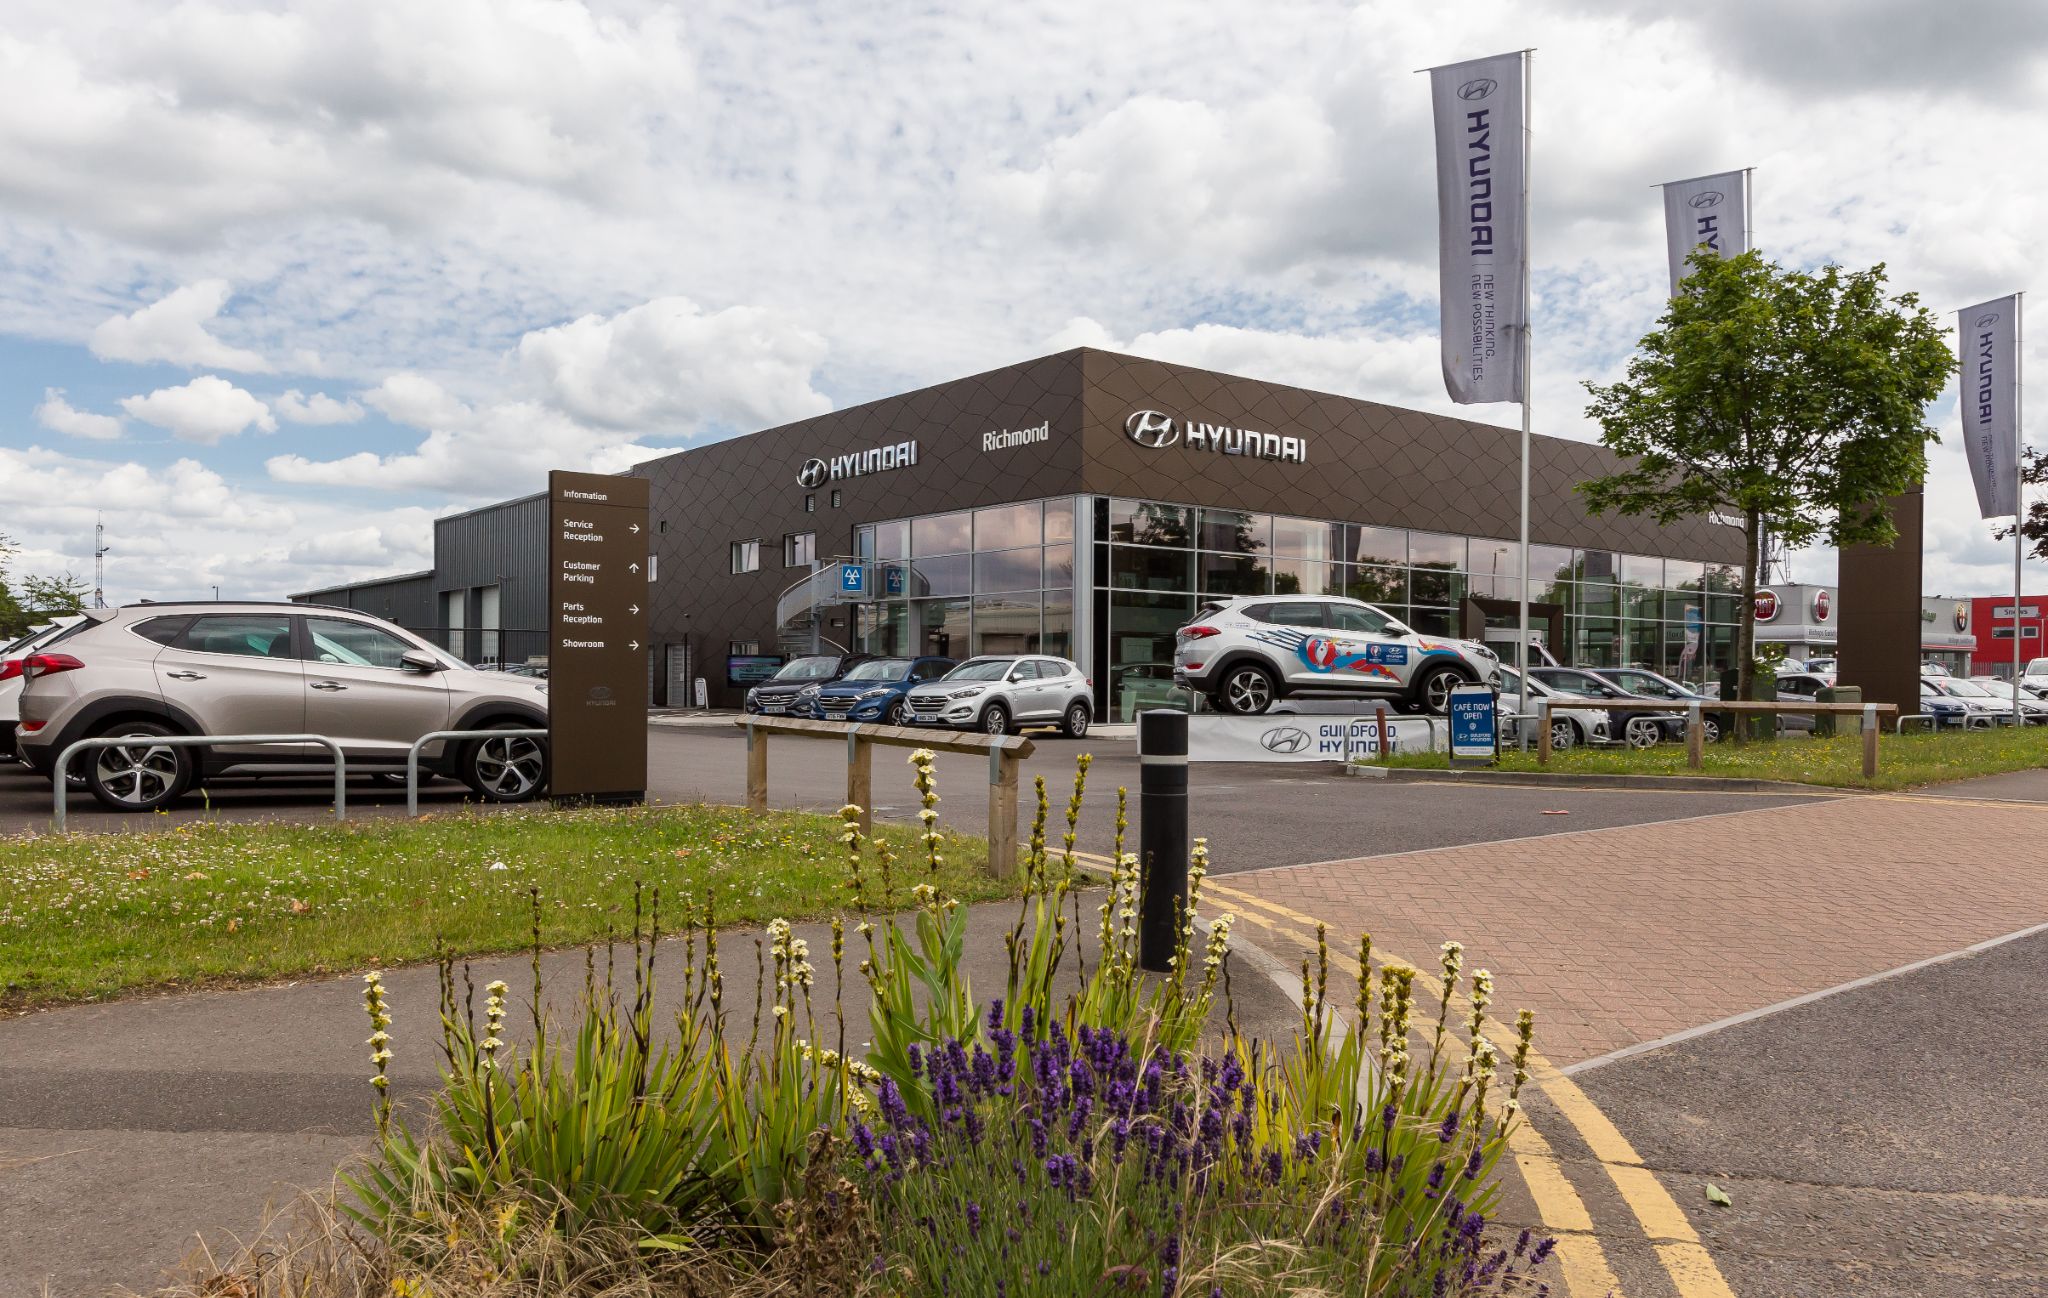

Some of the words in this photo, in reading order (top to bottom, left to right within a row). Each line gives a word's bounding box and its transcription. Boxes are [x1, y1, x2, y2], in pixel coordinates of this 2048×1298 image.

[1467, 109, 1493, 256] HYUNDAI
[1472, 274, 1482, 300] NEW
[1483, 274, 1494, 300] NEW
[1979, 332, 1993, 425] HYUNDAI
[983, 420, 1049, 452] Richmond
[1185, 421, 1306, 464] HYUNDAI
[830, 440, 918, 481] HYUNDAI
[563, 489, 608, 501] Information
[563, 519, 594, 529] Service
[563, 532, 603, 543] Reception
[563, 560, 601, 571] Customer
[563, 573, 594, 584] Parking
[563, 602, 584, 612] Parts
[563, 614, 602, 624] Reception
[563, 639, 604, 648] Showroom
[1473, 703, 1490, 711] NOW
[1463, 712, 1482, 720] OPEN
[1320, 725, 1396, 737] GUILDFOD
[1320, 741, 1396, 752] HYUNDI
